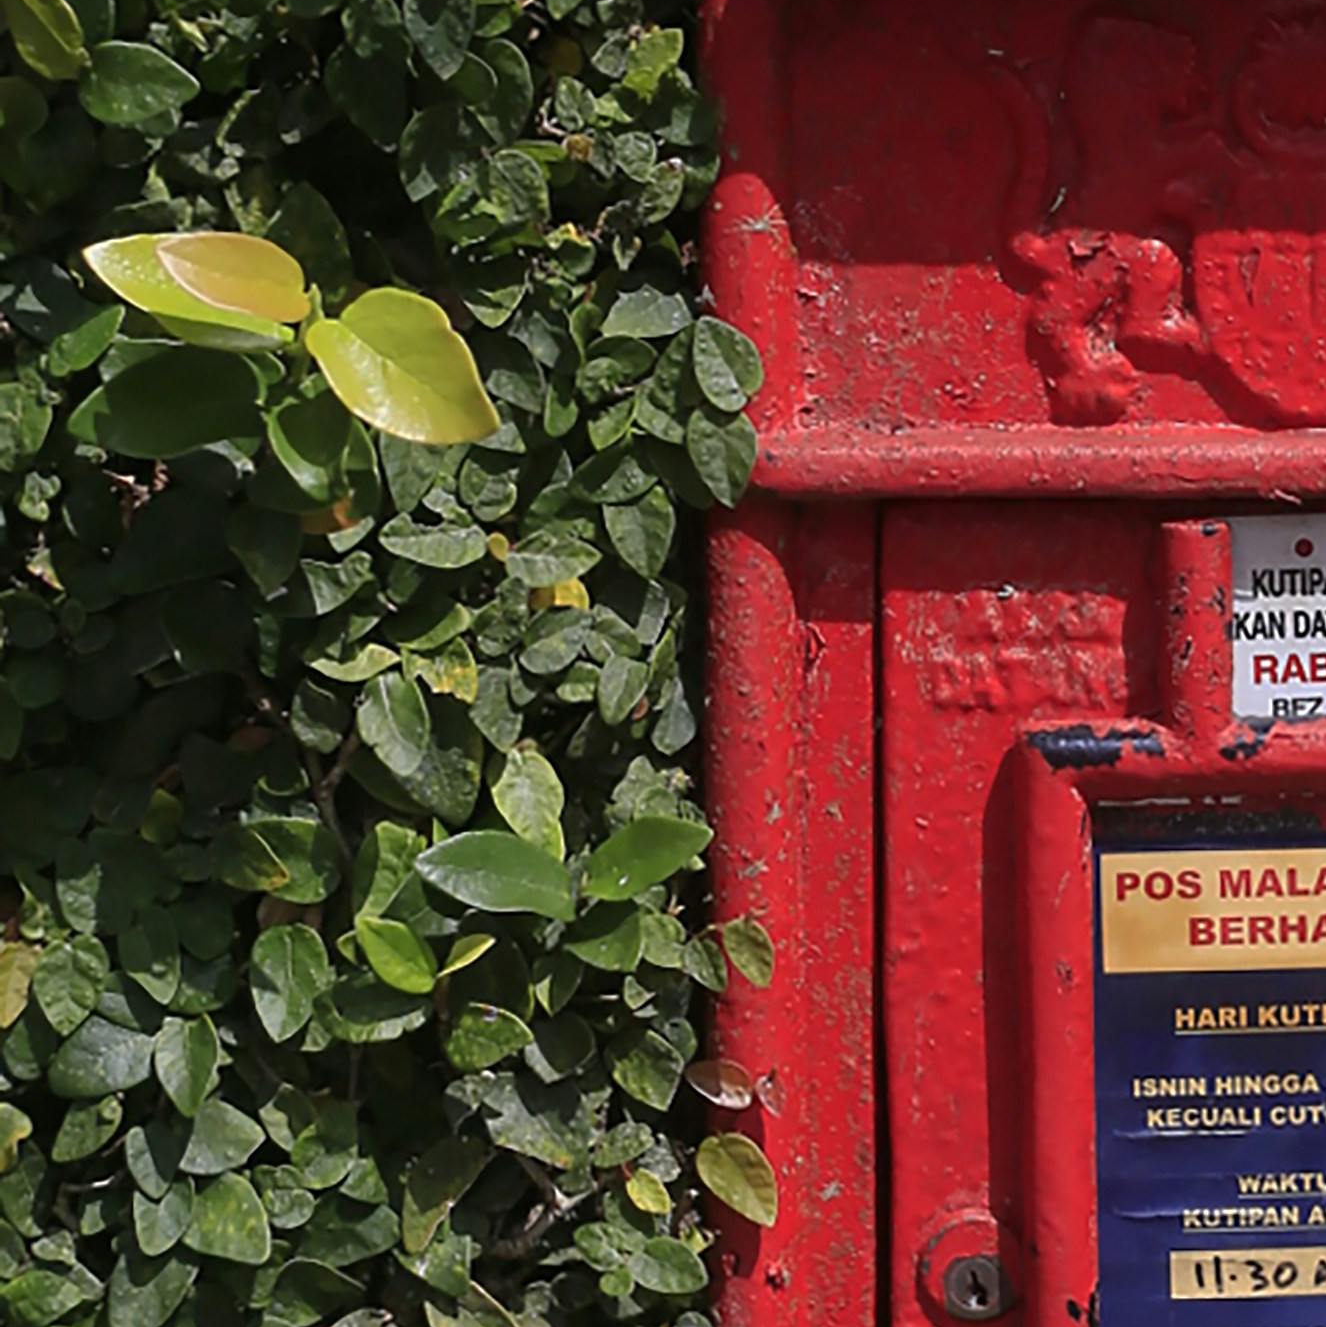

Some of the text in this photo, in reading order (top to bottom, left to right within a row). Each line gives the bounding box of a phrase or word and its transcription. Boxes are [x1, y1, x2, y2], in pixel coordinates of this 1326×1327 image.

[1115, 871, 1202, 901] POS
[1175, 1007, 1248, 1029] HARI
[1133, 1078, 1207, 1097] ISNIN
[1215, 1074, 1320, 1095] HINGGA
[1147, 1107, 1261, 1128] KECUALI
[1183, 1207, 1299, 1227] KUTIPAN
[1194, 1255, 1299, 1293] 11.30
